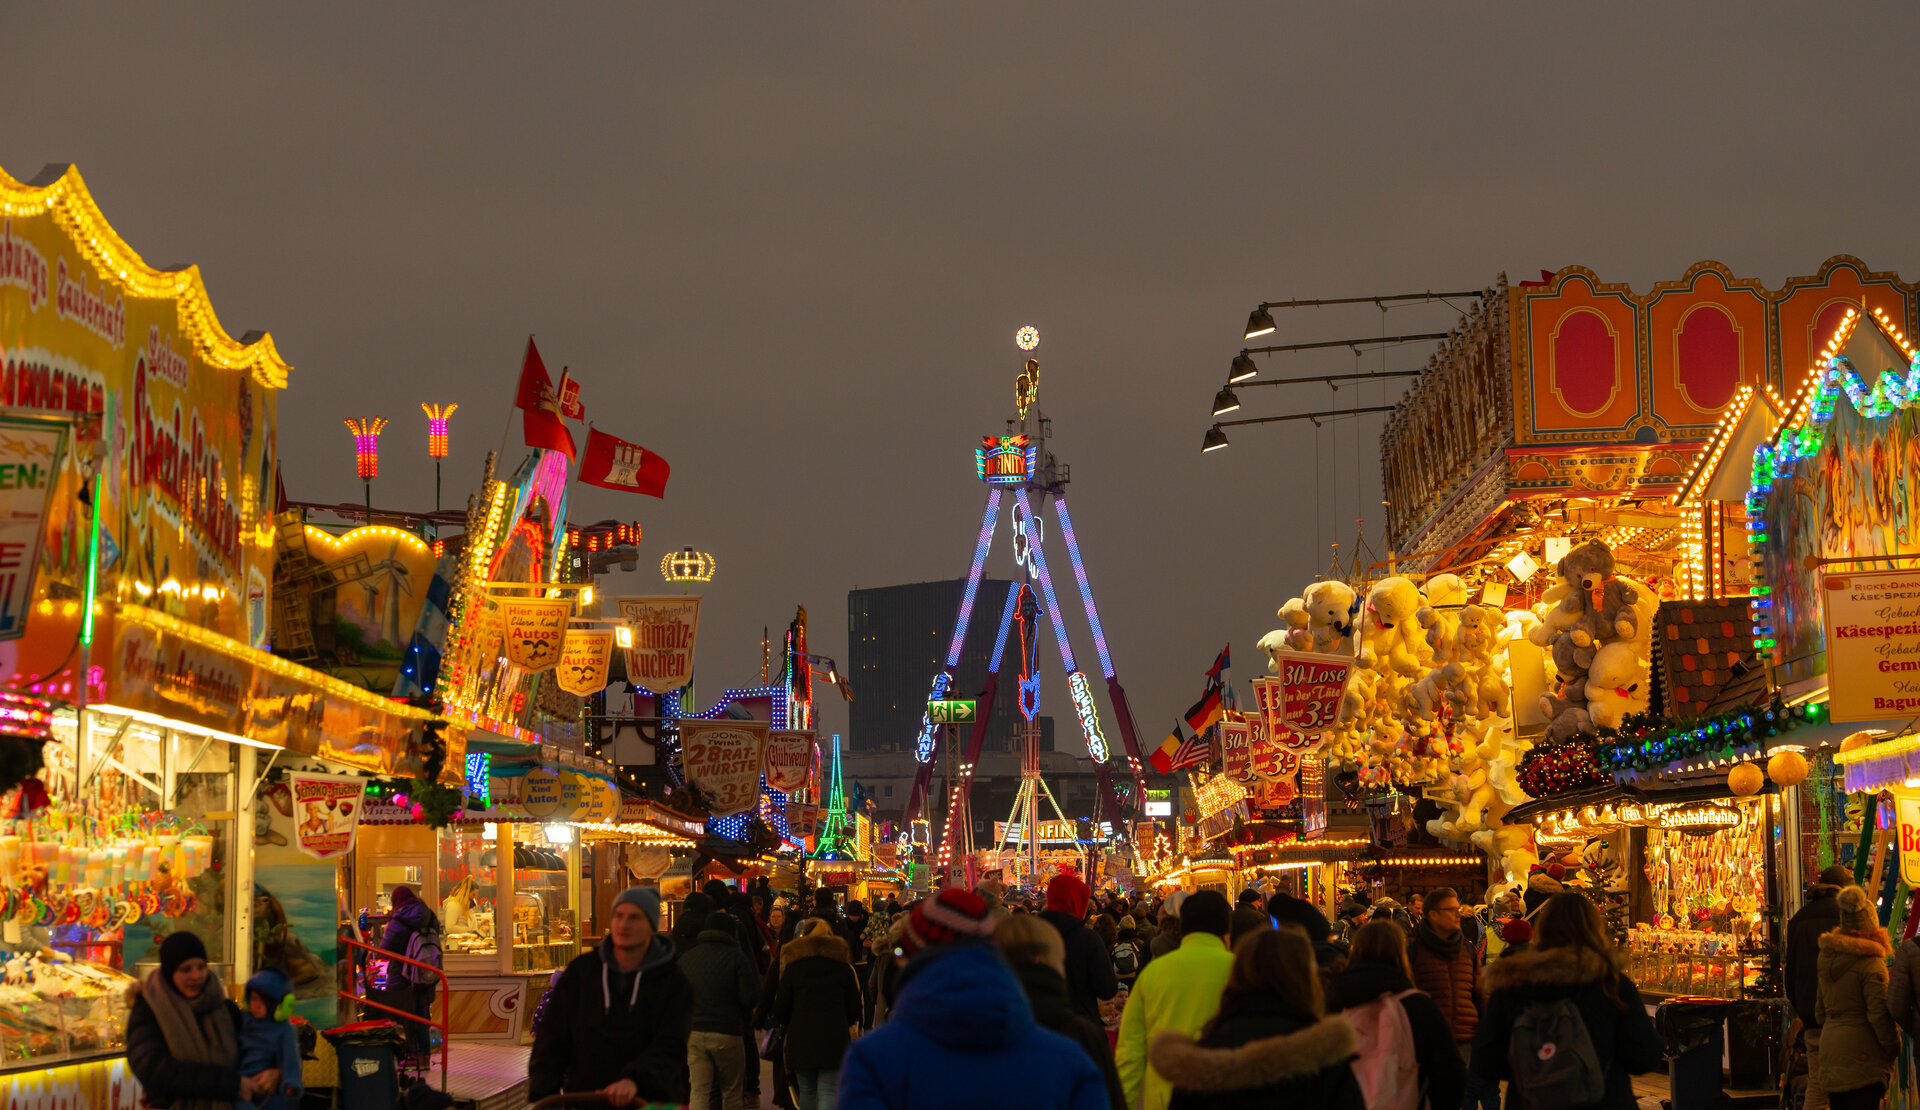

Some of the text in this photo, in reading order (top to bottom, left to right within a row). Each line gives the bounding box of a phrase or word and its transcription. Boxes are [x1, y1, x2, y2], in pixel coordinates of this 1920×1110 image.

[508, 606, 563, 618] Hier auch
[512, 627, 559, 640] Autos
[635, 619, 693, 649] hmalz-
[566, 637, 606, 646] ier auch
[562, 655, 604, 666] Autos
[630, 649, 686, 679] kuchen
[1283, 665, 1346, 687] 30 Lose
[1071, 674, 1094, 718] SUPER
[1296, 690, 1311, 701] der
[1286, 709, 1304, 721] nur
[711, 731, 738, 739] DOM
[1083, 715, 1106, 761] GIANT
[688, 744, 707, 766] 2
[768, 744, 808, 767] Glühwein
[526, 794, 558, 804] Autos
[952, 869, 962, 877] 12
